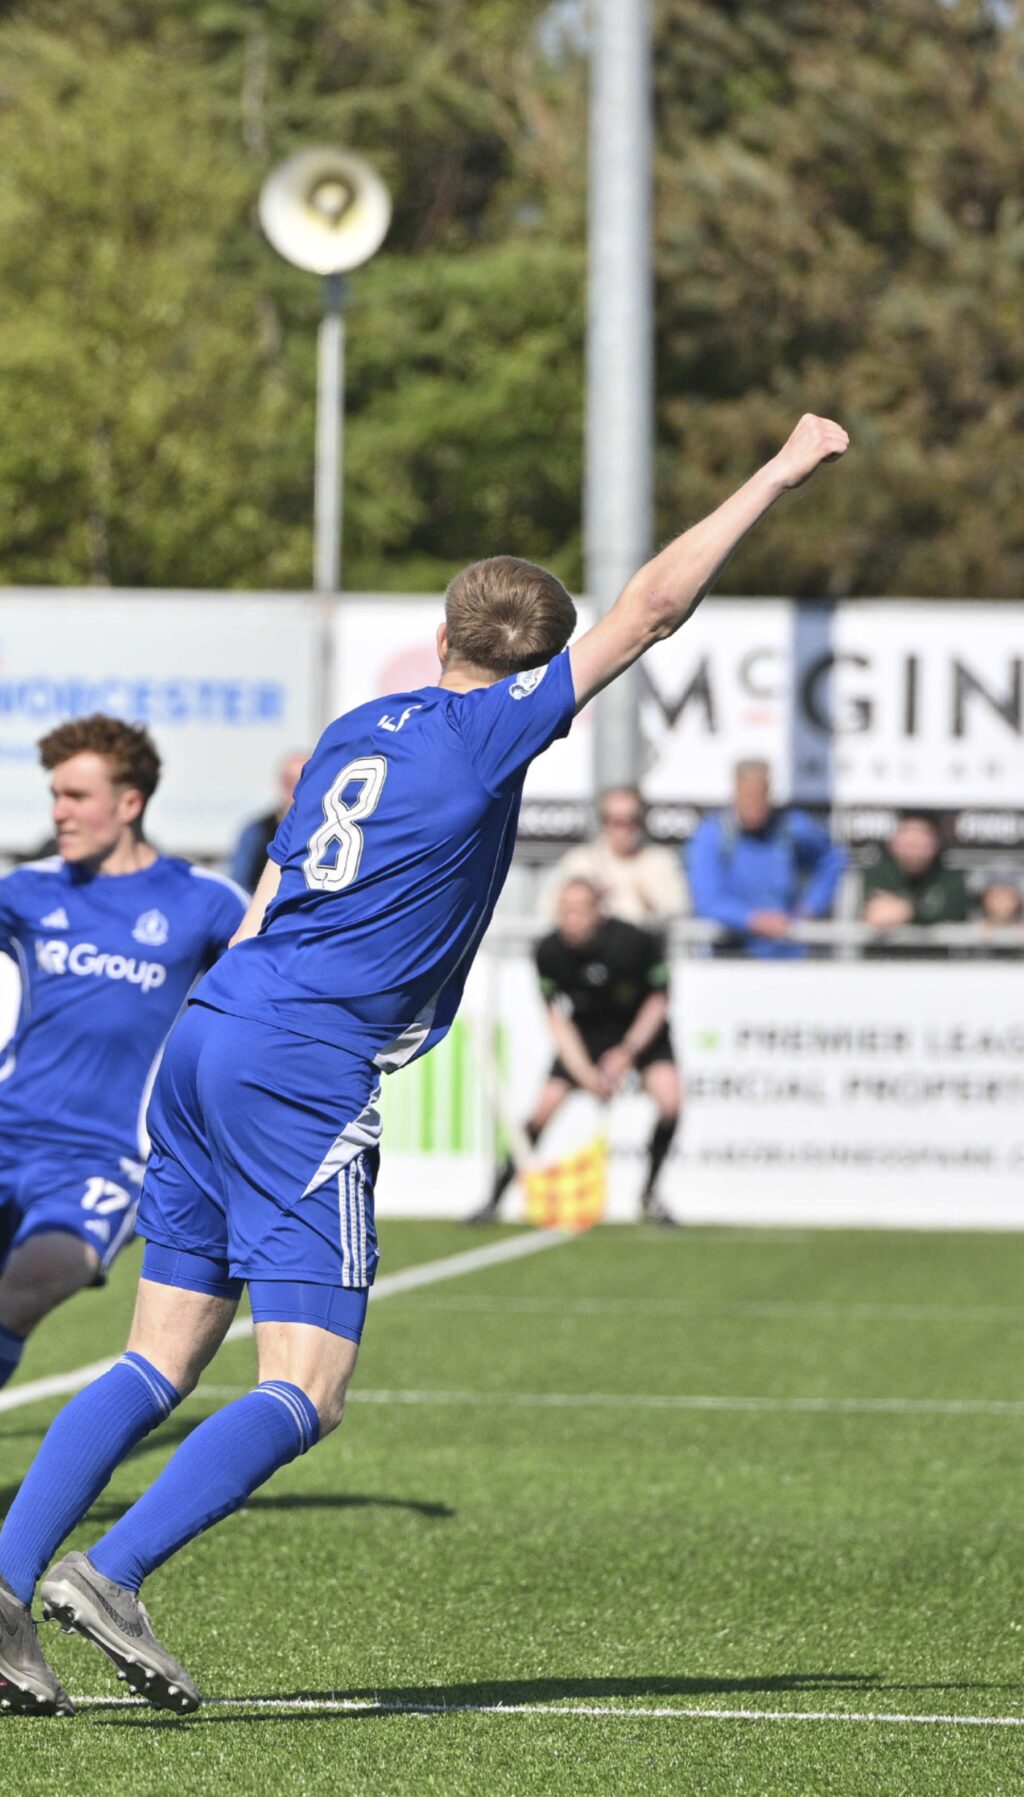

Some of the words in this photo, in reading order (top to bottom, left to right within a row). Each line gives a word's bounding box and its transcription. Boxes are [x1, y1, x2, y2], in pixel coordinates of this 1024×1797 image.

[302, 755, 388, 892] 8
[734, 1020, 913, 1052] PREMIER
[80, 1176, 131, 1215] 17
